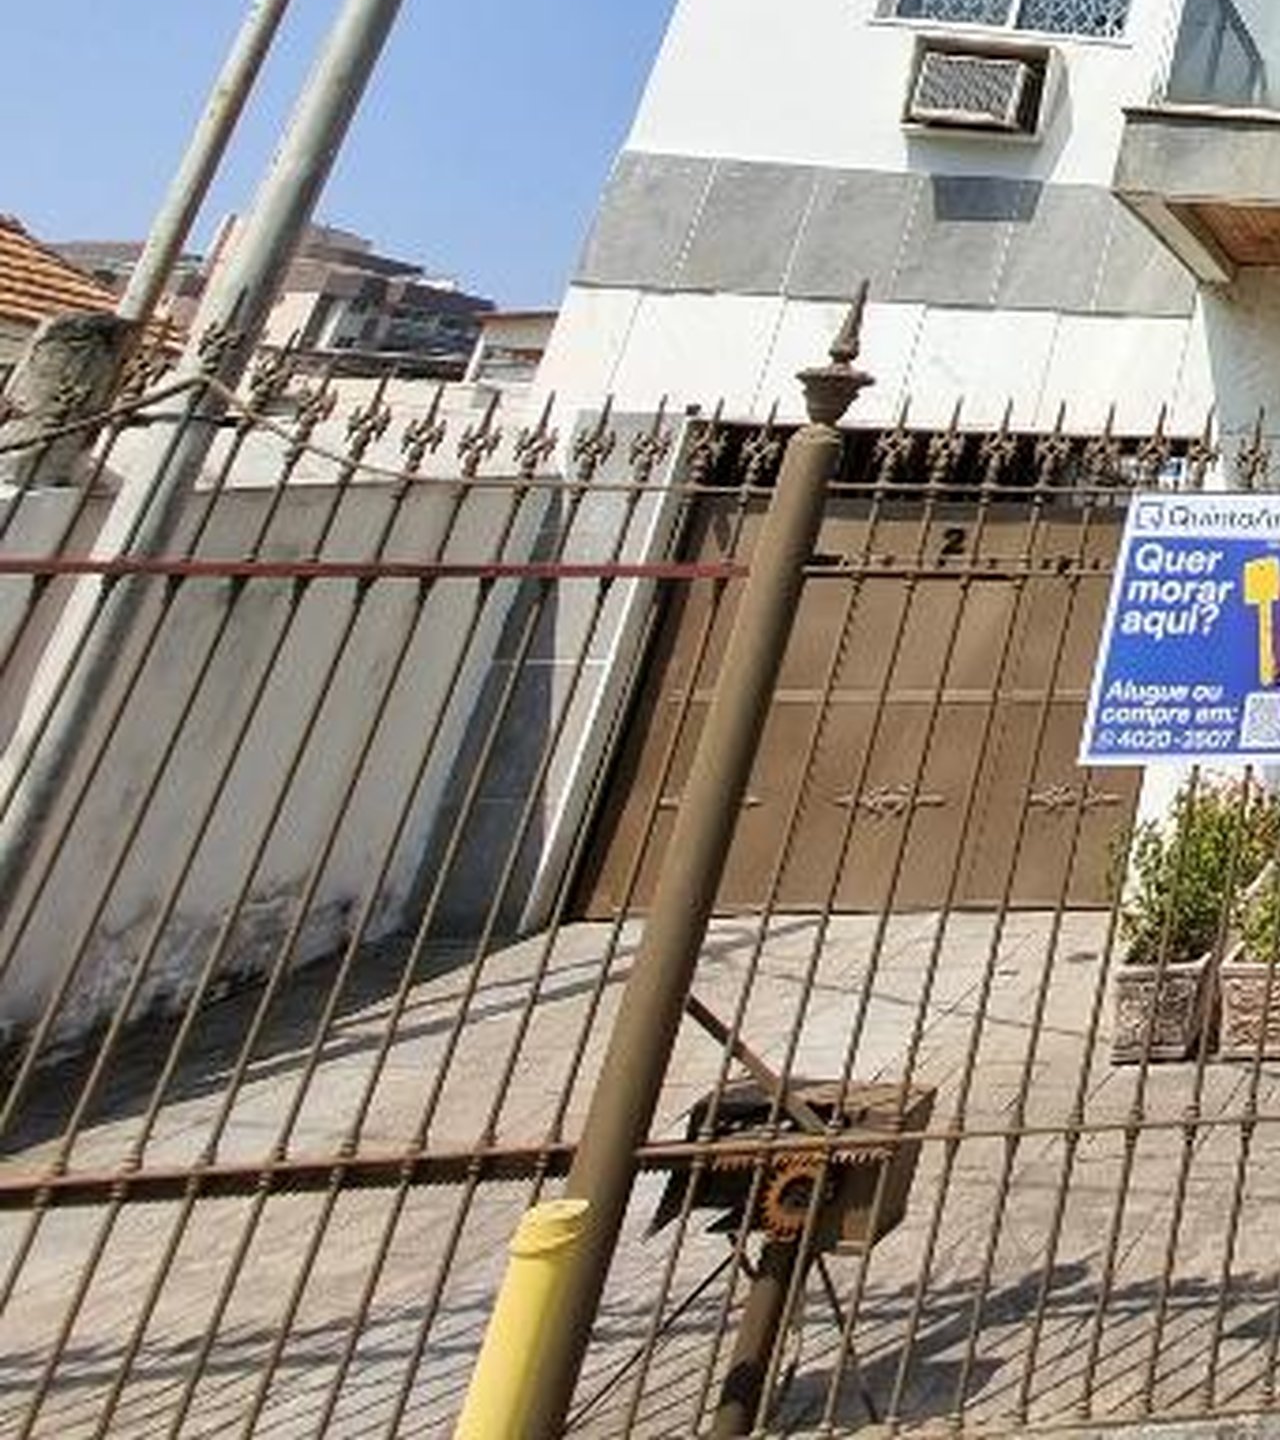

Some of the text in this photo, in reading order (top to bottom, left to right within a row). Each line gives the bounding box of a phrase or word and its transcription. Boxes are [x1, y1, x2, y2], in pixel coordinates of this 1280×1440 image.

[941, 528, 965, 555] 2
[1134, 543, 1223, 574] Quer
[1126, 578, 1234, 603] morar
[1120, 604, 1219, 641] aqui?
[1105, 679, 1224, 706] Alugue ou
[1101, 707, 1239, 727] compre em:
